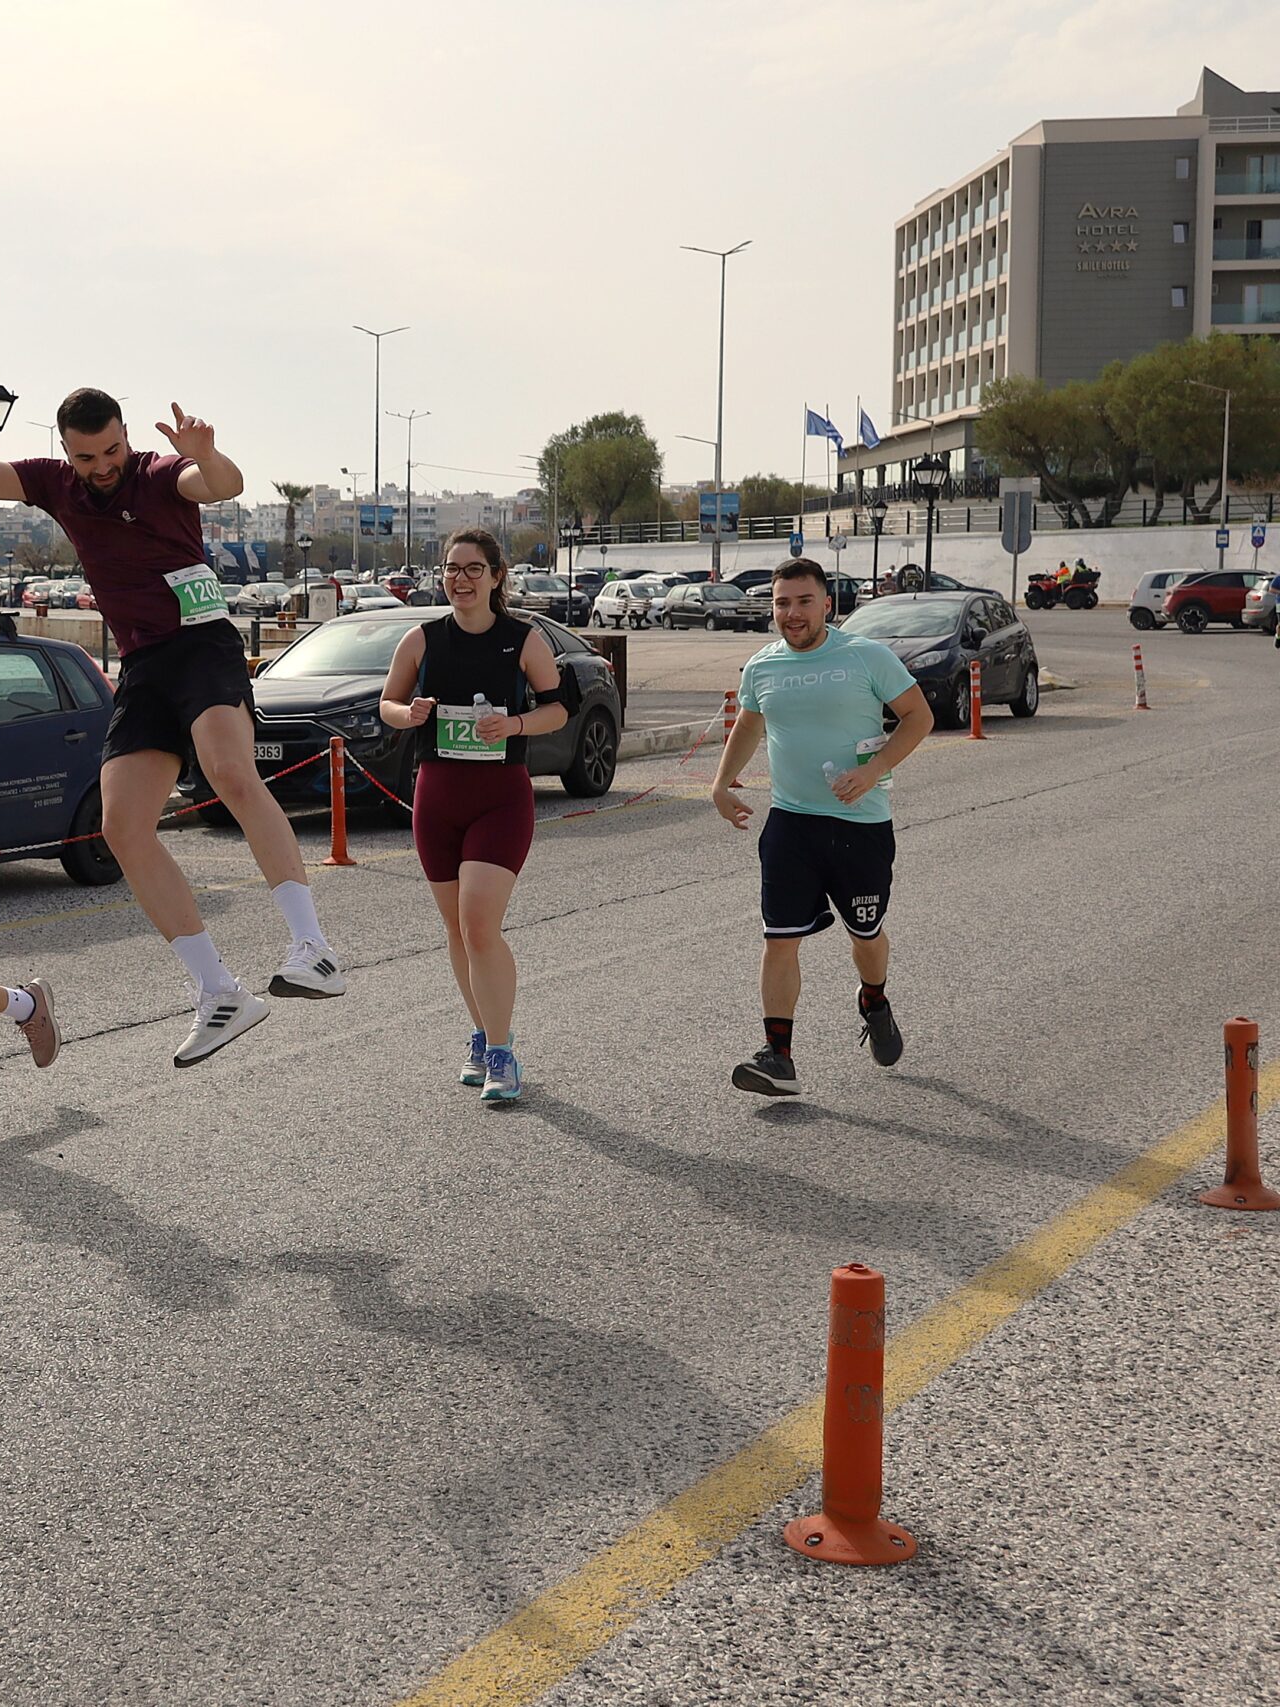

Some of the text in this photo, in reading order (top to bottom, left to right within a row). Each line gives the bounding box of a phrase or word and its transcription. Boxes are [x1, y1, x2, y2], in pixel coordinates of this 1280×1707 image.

[1078, 202, 1139, 219] AVRA
[1076, 224, 1140, 236] HOTEL
[1077, 260, 1130, 272] SMILE HOTELS
[856, 905, 877, 923] 93
